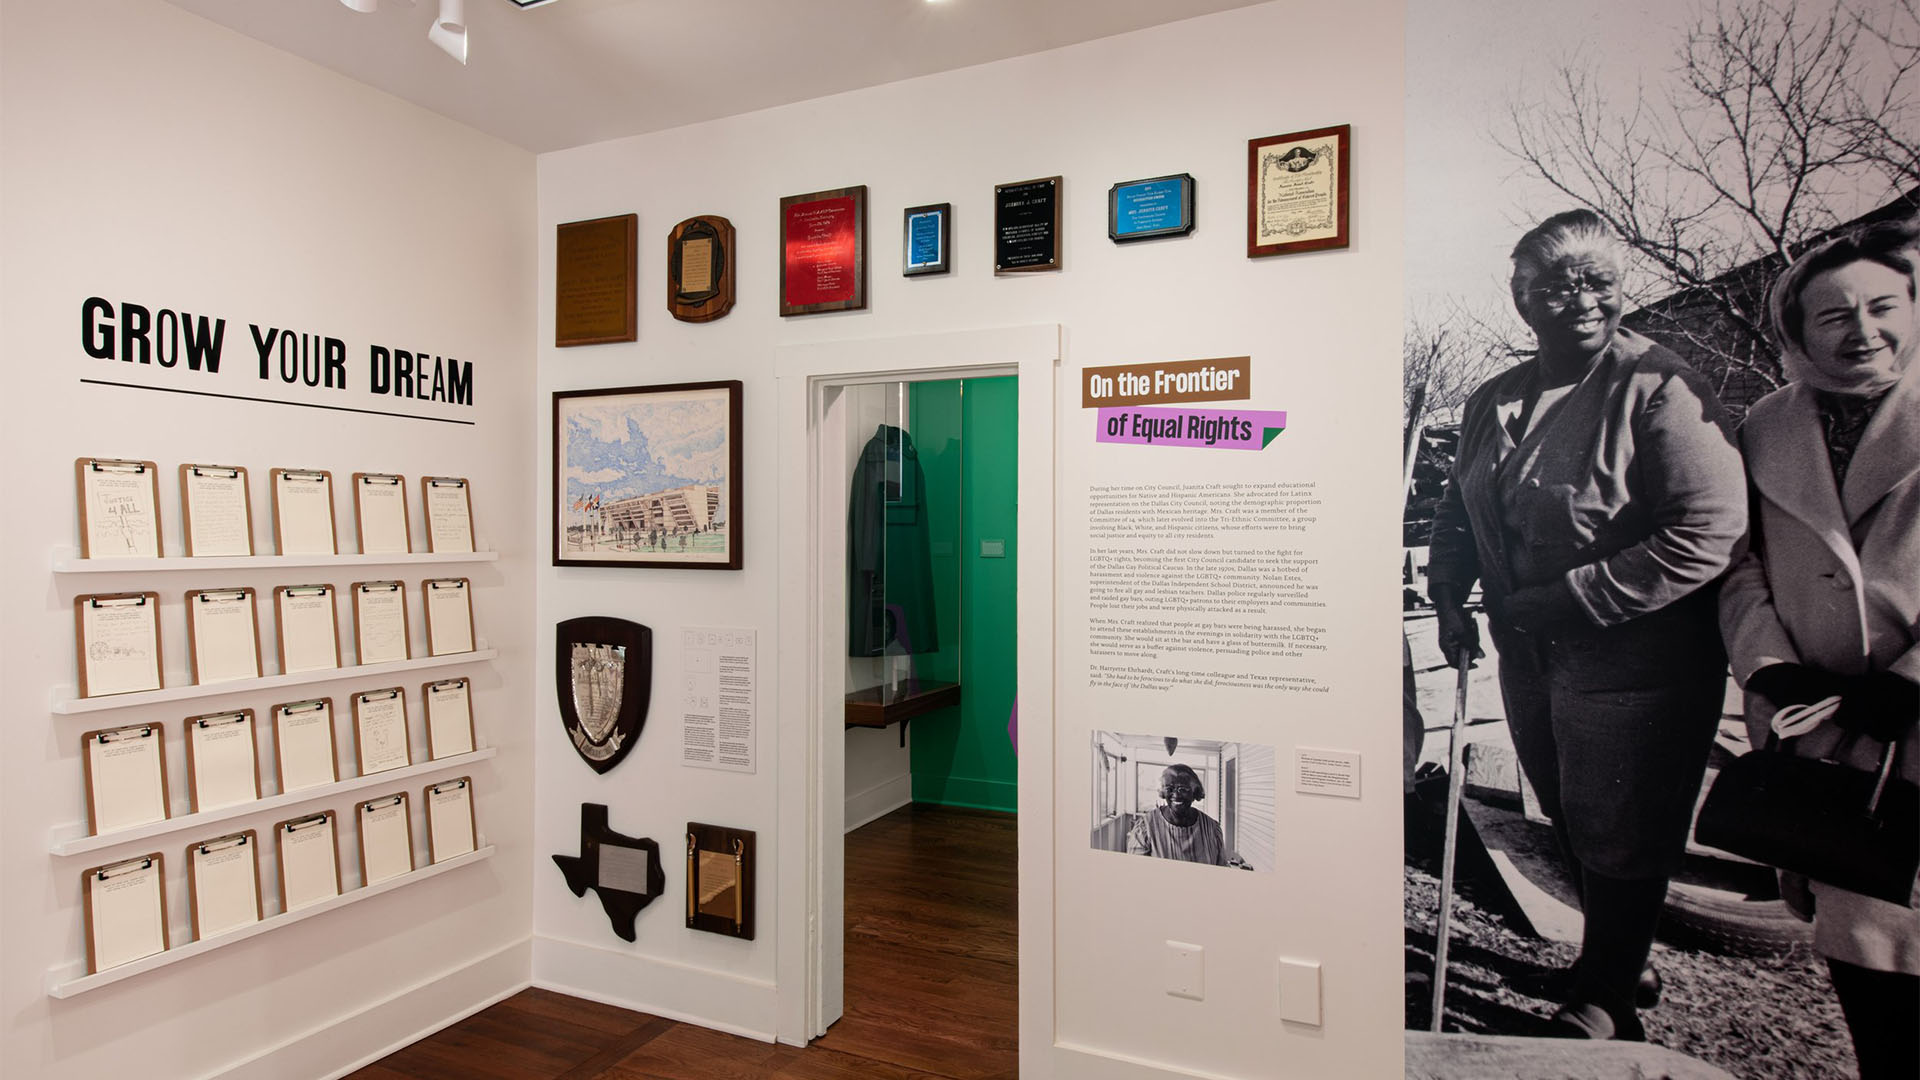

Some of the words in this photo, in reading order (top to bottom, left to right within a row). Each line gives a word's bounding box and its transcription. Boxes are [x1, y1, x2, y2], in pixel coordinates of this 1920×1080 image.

[82, 297, 225, 373] GROW
[249, 324, 346, 389] YOUR
[370, 344, 473, 406] DREAM
[1090, 374, 1112, 398] On
[1118, 372, 1150, 396] the
[1155, 366, 1240, 394] Frontier
[1108, 413, 1128, 436] of
[1132, 414, 1183, 443] Equal
[1188, 416, 1252, 445] Rights
[120, 504, 140, 514] ALL
